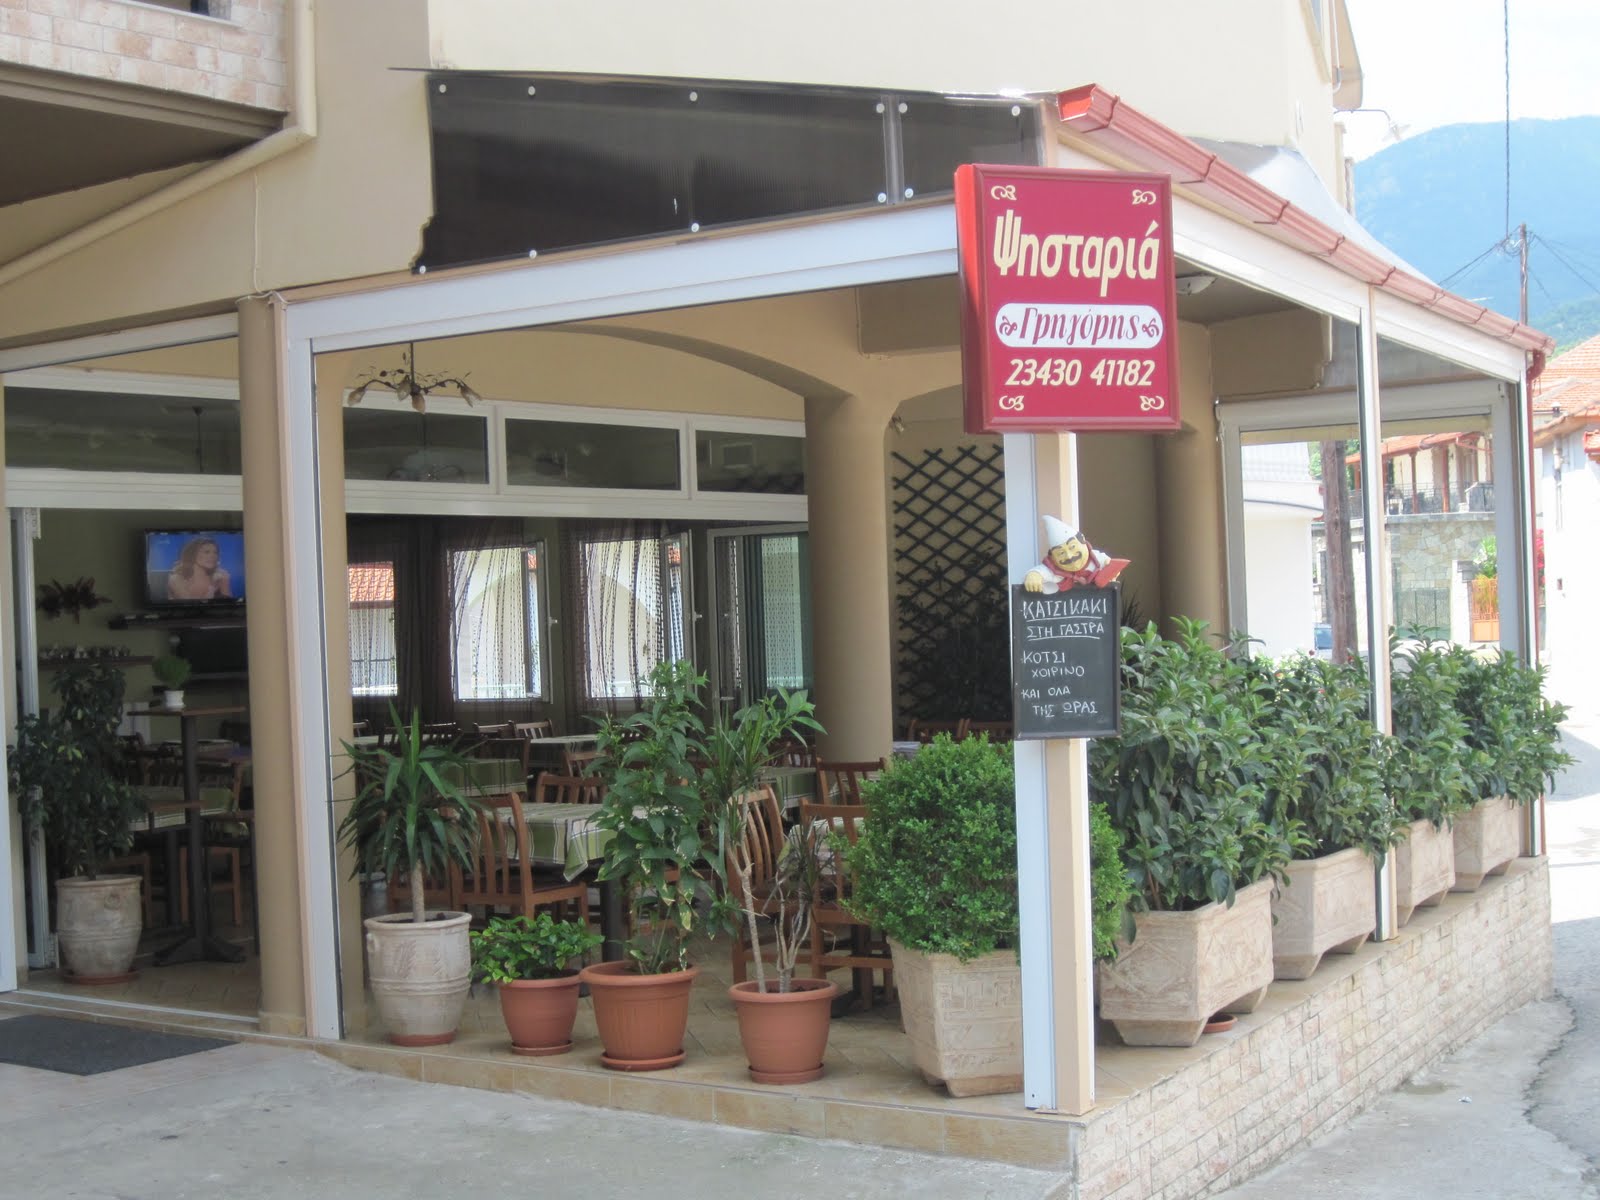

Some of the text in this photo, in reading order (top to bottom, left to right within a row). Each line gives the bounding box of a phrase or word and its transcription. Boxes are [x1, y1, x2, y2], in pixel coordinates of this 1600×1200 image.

[993, 209, 1159, 297] Ψησταριά
[1019, 307, 1140, 345] Γρηγόρης
[1004, 358, 1155, 386] 23430 41182
[1022, 598, 1107, 620] ΚΑΤΣΙΚΑΚΙ
[1027, 621, 1105, 638] ΣΤΗ ΓΑΣΤΡΑ
[1022, 650, 1066, 664] ΚΟΤΣΙ
[1032, 665, 1085, 678] ΧΟΙΡΙΝΟ
[1021, 685, 1071, 699] ΚΑΙ ΟΛΑ
[1032, 701, 1098, 718] ΤΗΣ ΩΡΑΣ
